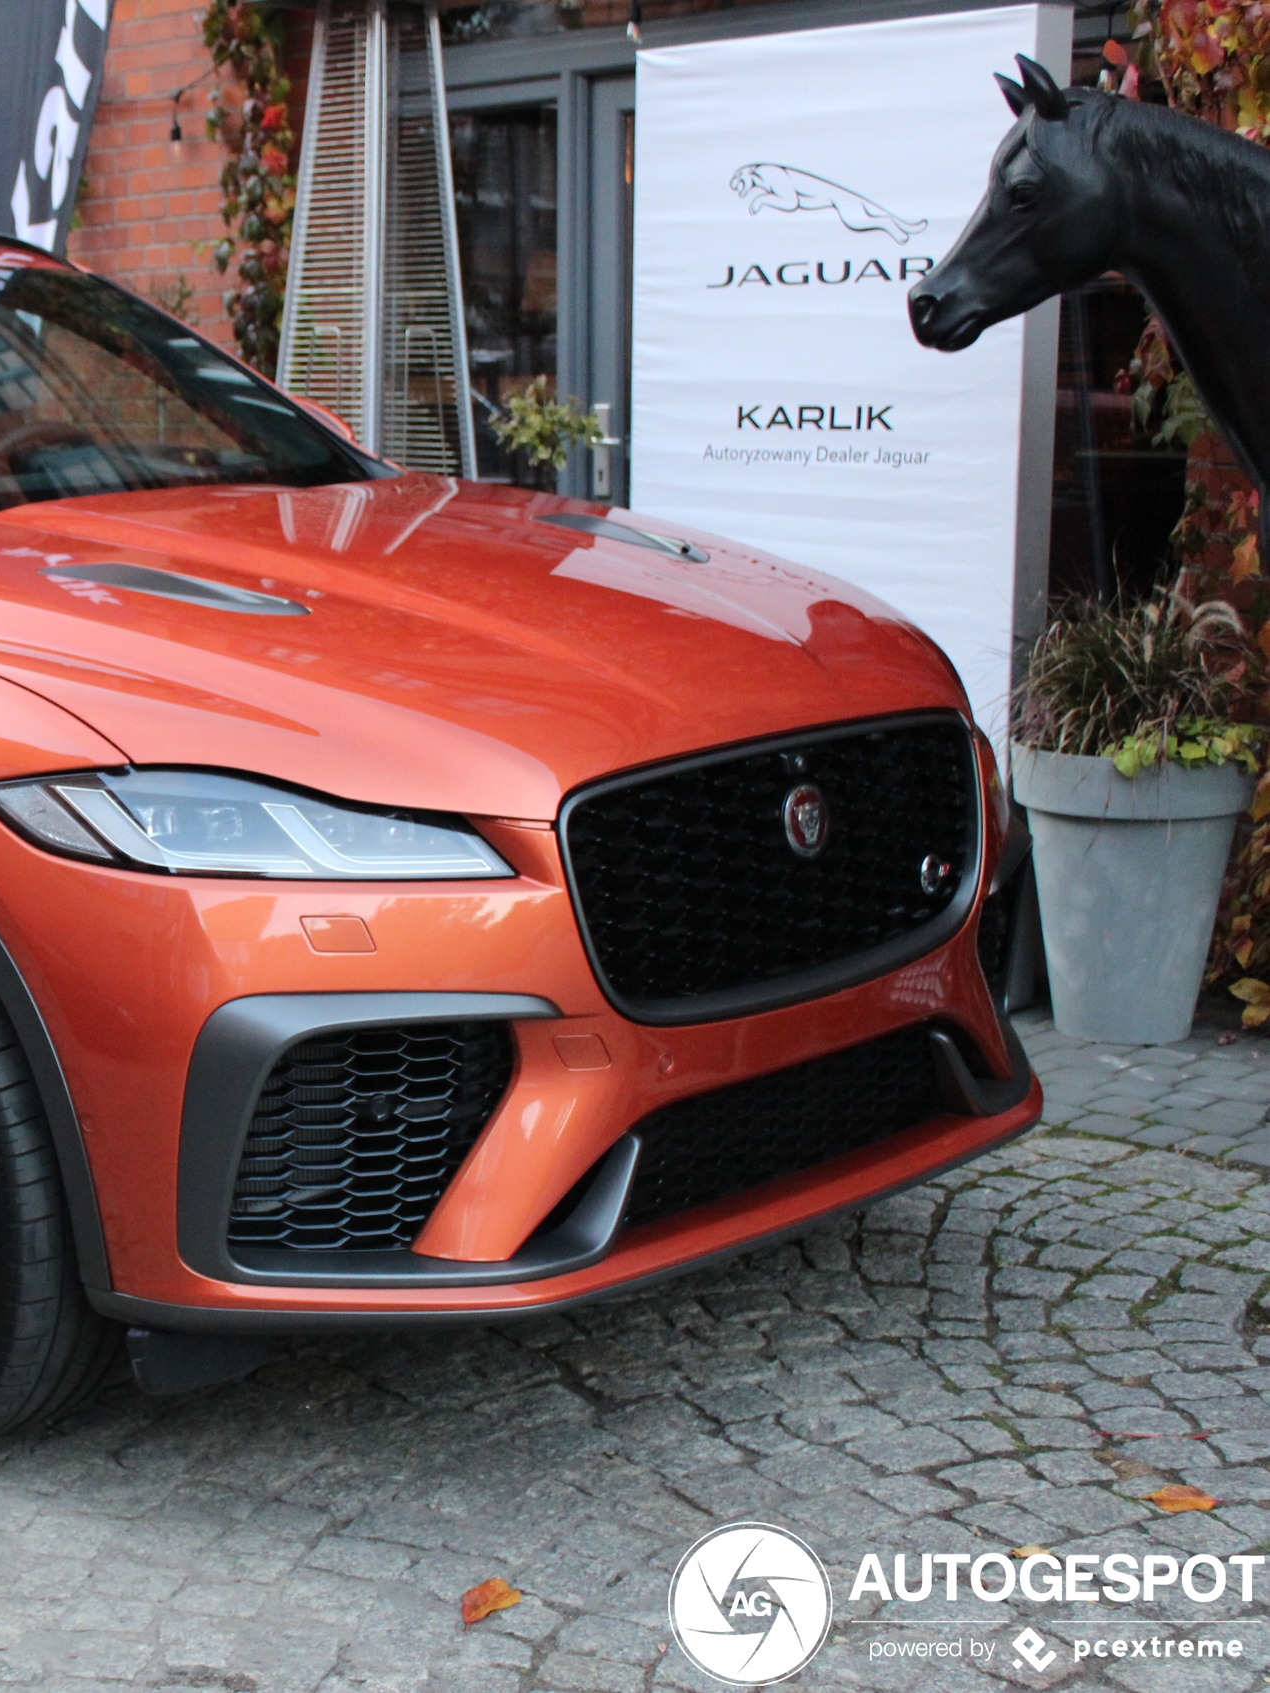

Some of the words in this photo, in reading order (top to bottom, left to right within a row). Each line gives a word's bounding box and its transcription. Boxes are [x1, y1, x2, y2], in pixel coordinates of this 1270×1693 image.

[706, 256, 936, 289] JAGUAR
[736, 404, 895, 432] KARLIK
[702, 443, 811, 467] Autoryzowany
[816, 445, 870, 464] Dealer
[872, 447, 930, 469] Jaguar
